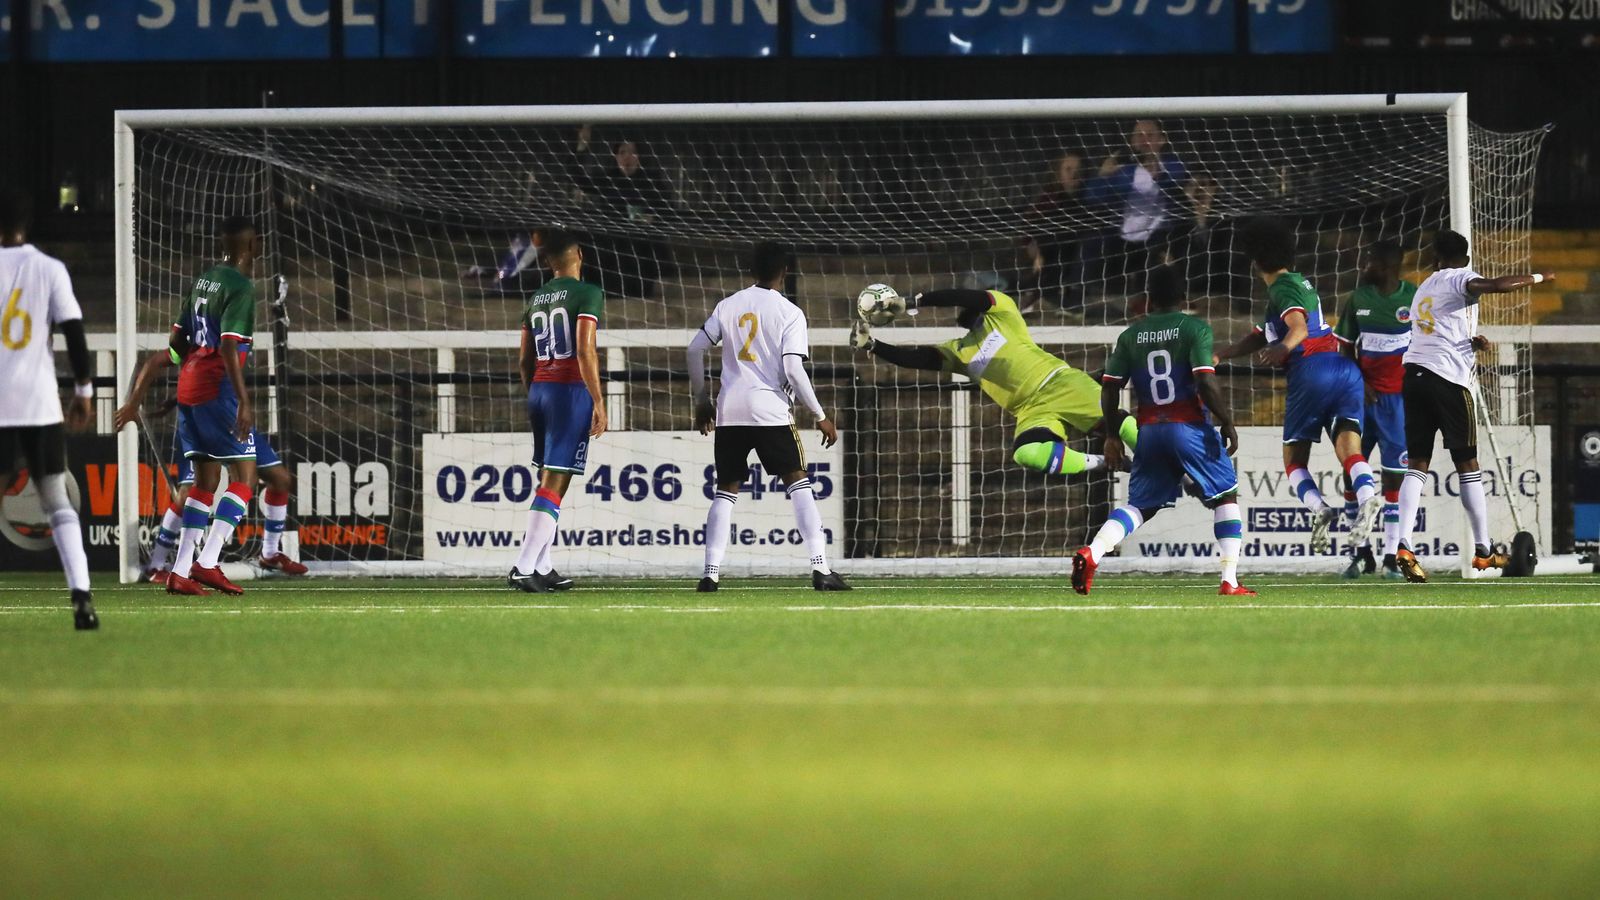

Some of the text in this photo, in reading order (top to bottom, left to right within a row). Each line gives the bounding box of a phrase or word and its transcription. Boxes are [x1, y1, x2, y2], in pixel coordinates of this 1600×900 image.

[2, 287, 33, 351] 6
[531, 307, 573, 360] 20
[737, 312, 759, 362] 2
[1136, 327, 1180, 344] BARAWA
[1146, 349, 1176, 406] 8
[436, 464, 543, 503] 020
[585, 463, 683, 502] 466
